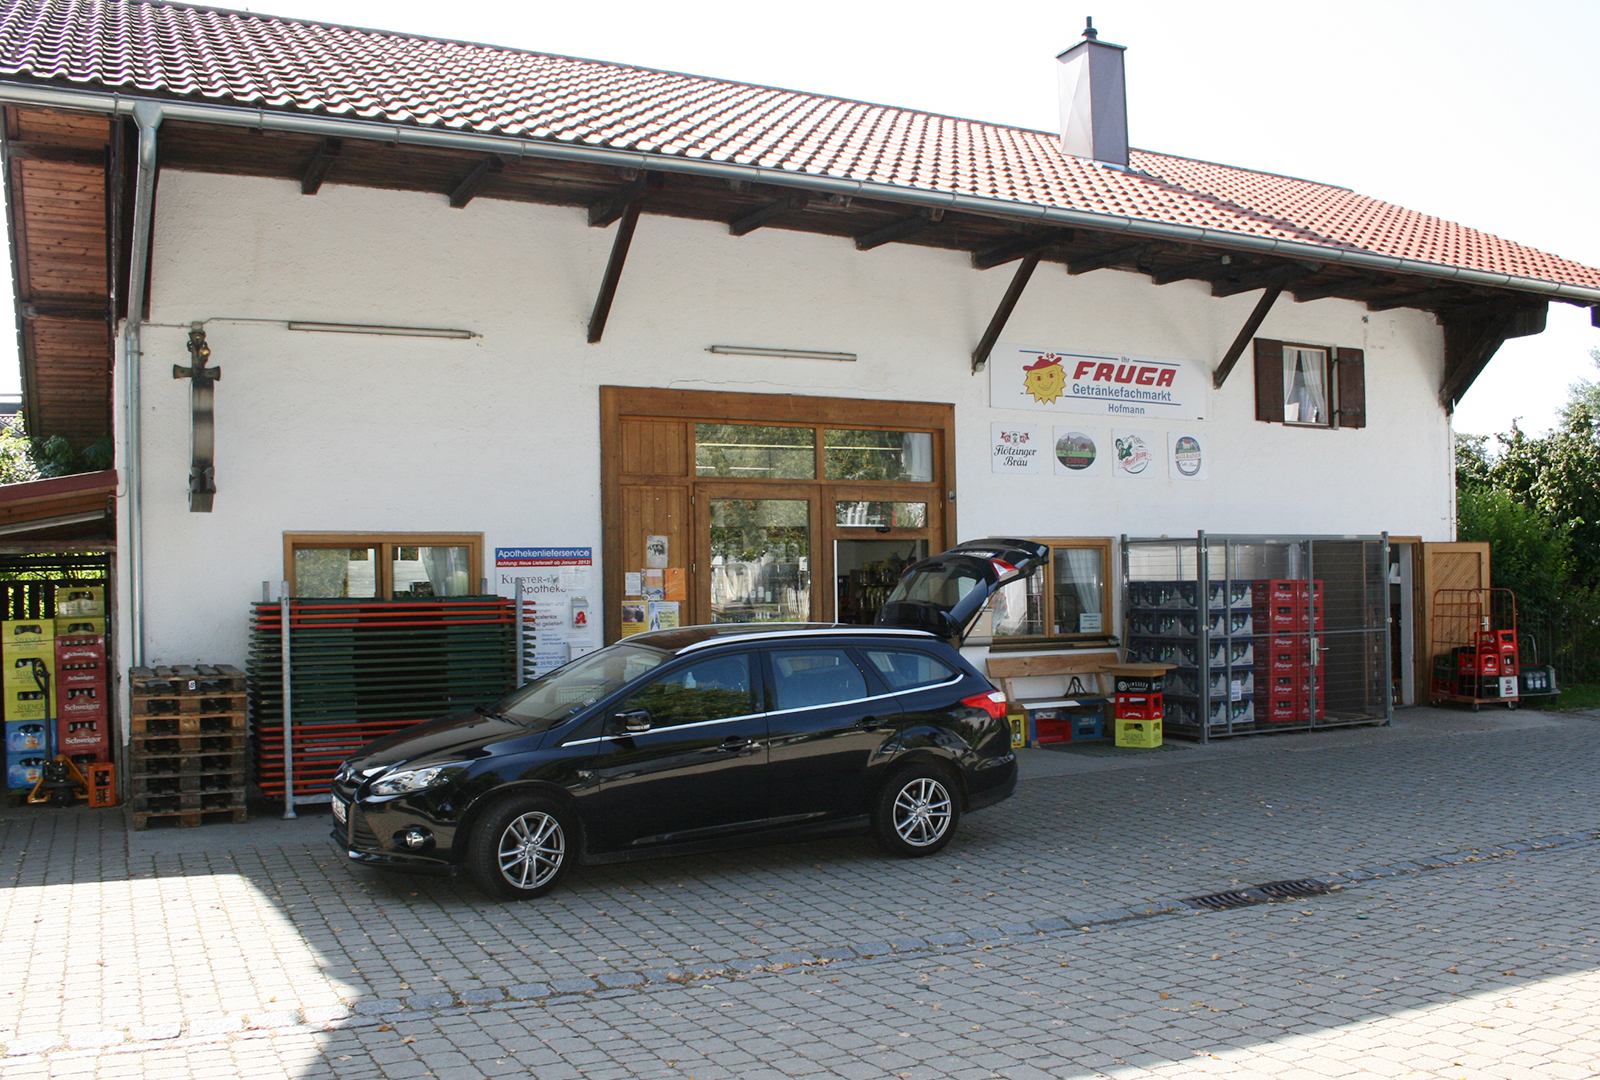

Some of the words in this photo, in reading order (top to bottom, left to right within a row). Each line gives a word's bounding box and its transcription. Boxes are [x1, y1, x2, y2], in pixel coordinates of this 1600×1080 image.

[1073, 361, 1177, 388] FRUGA
[1072, 383, 1172, 402] Getränkefachmarkt
[1108, 403, 1145, 415] Hofmann
[993, 444, 1037, 458] Flötzinger
[1003, 455, 1028, 467] Bräu
[497, 549, 590, 558] Apothekenlieferservice
[64, 702, 100, 711] Schweiger
[65, 736, 101, 745] Schweiger
